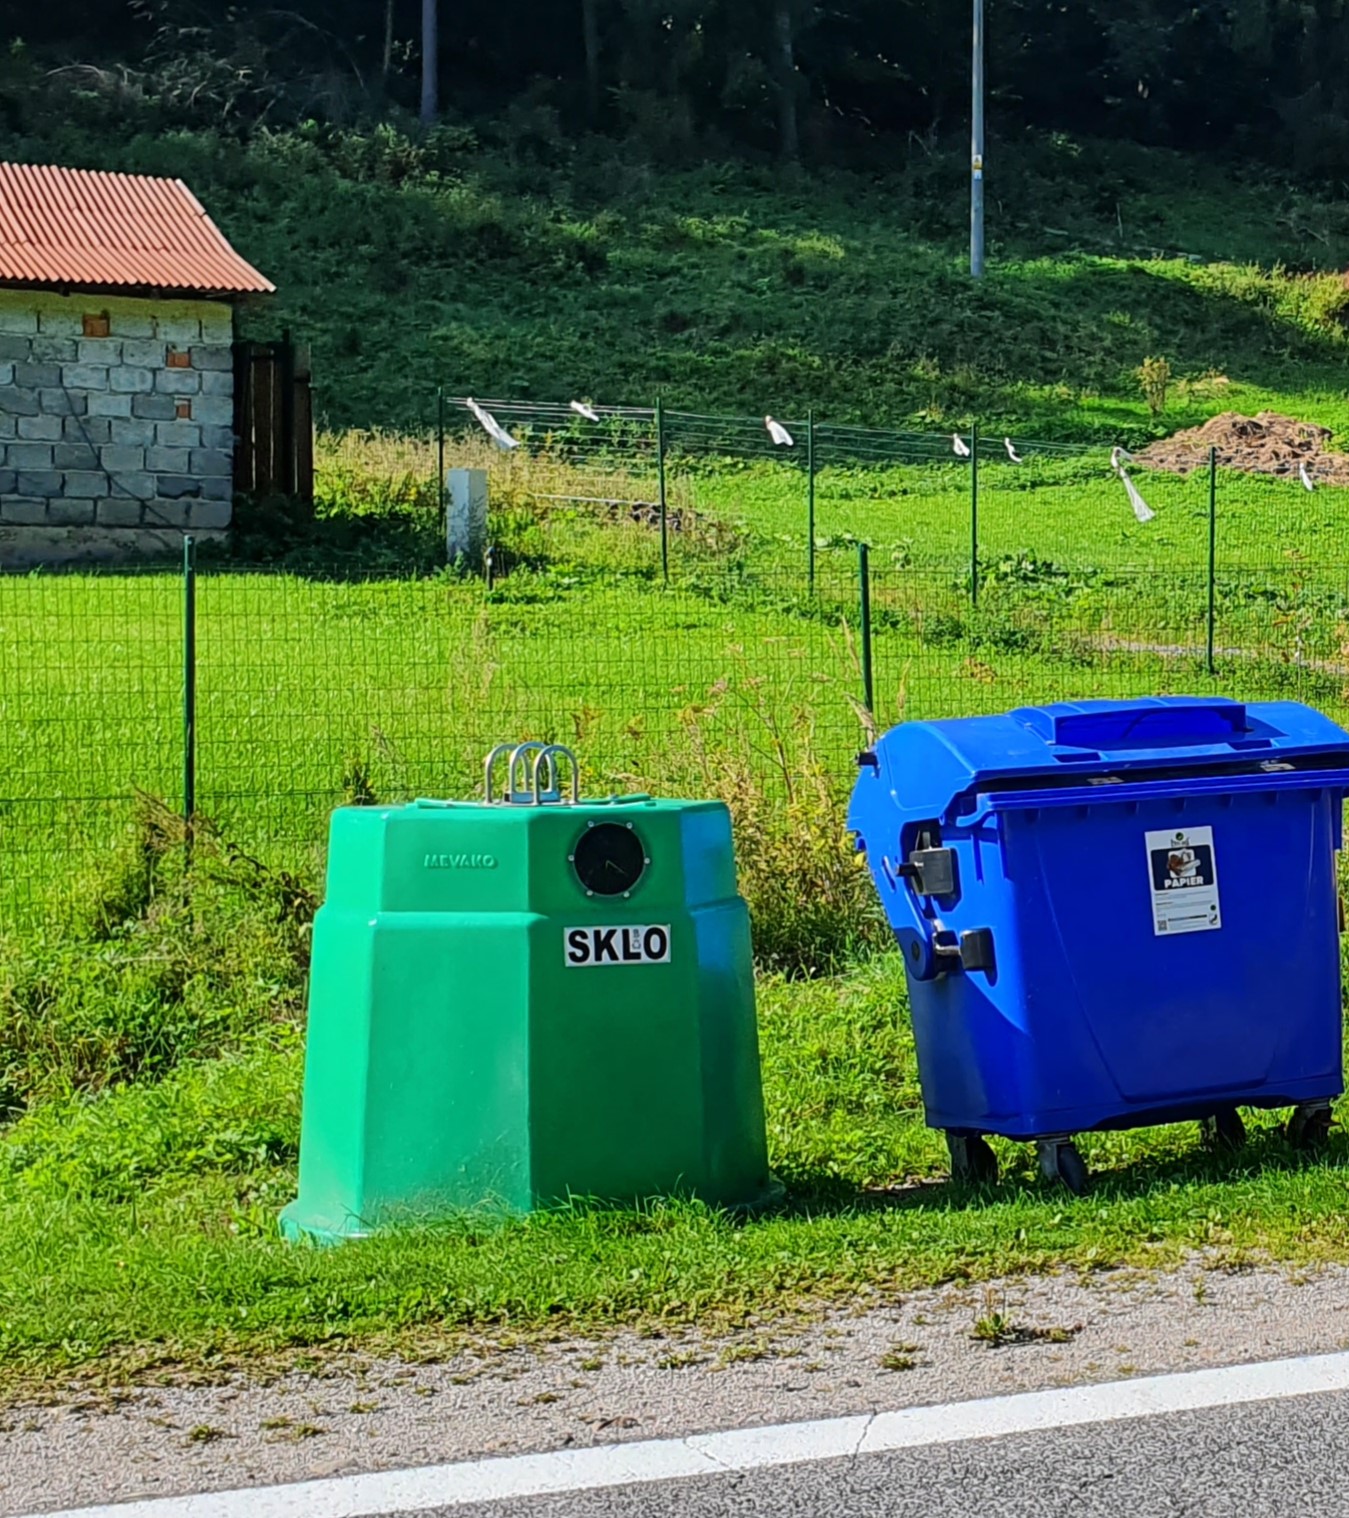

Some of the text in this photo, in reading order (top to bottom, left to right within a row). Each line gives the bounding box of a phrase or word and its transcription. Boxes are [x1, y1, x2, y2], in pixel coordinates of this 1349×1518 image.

[424, 854, 497, 868] MEVAKO
[1164, 876, 1204, 888] PAPIER
[568, 927, 668, 963] SKLO
